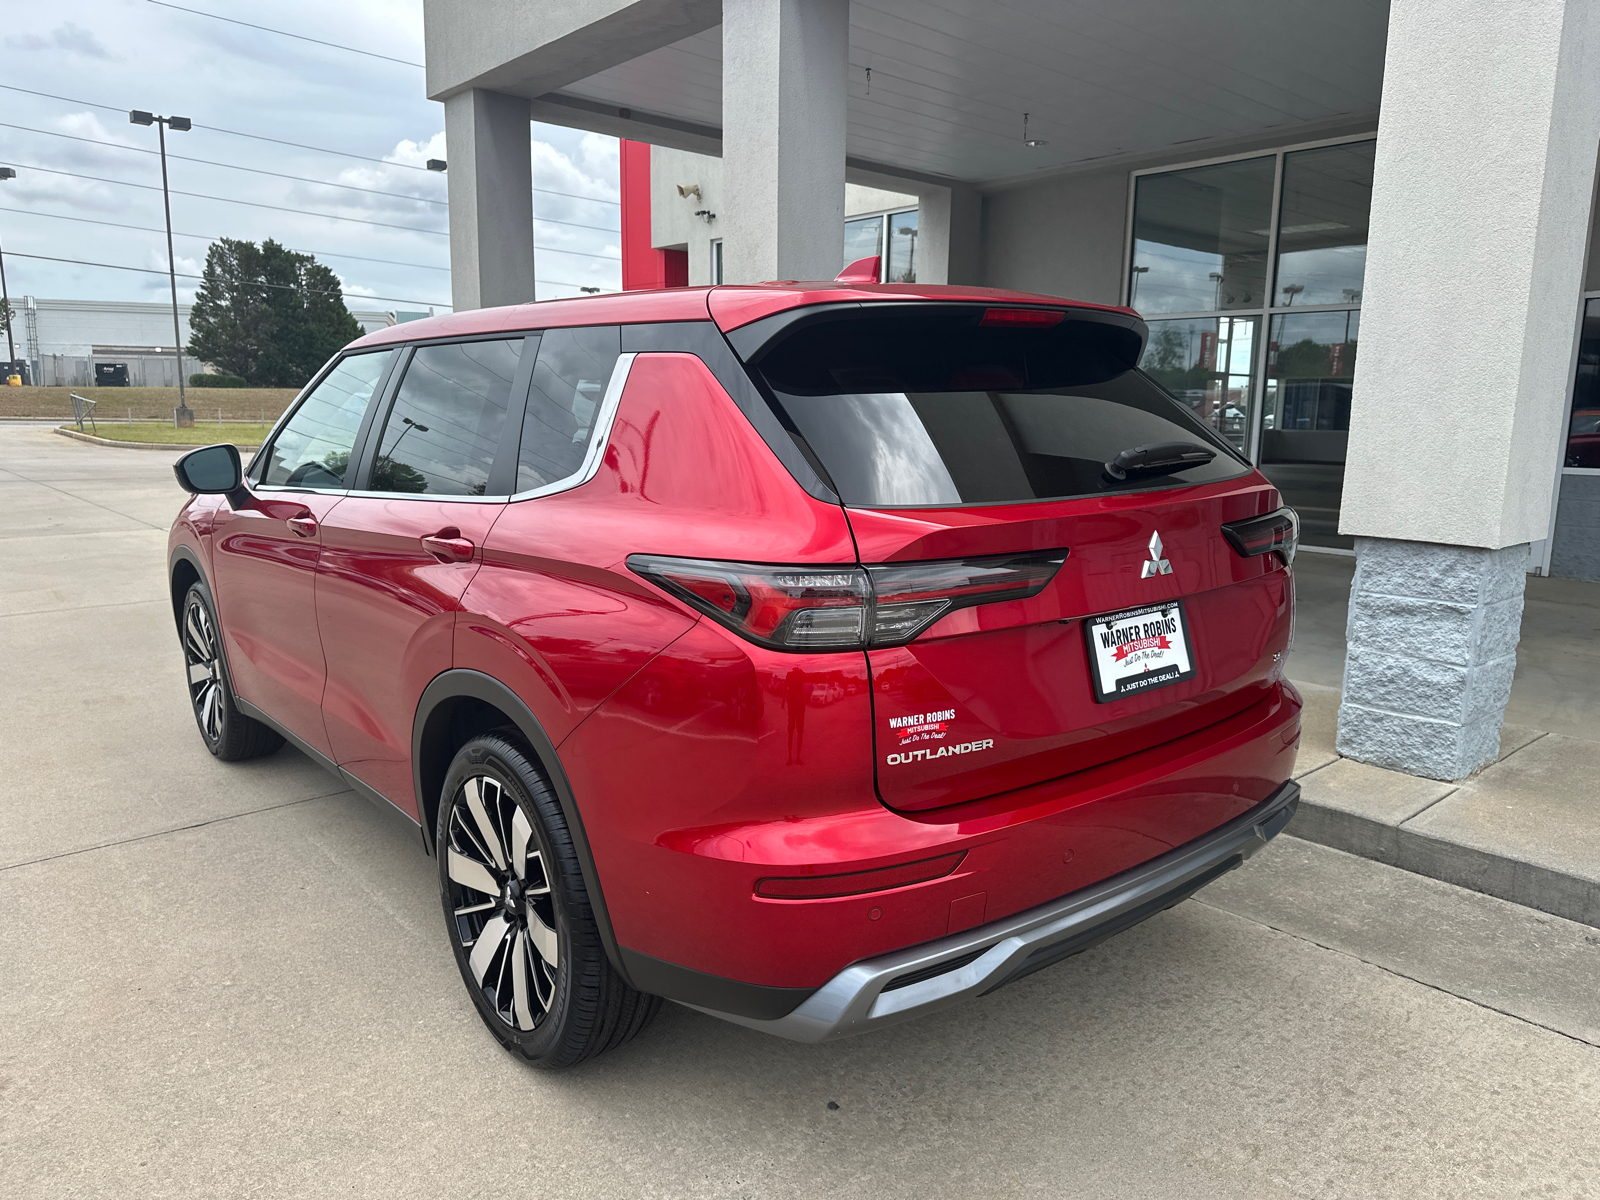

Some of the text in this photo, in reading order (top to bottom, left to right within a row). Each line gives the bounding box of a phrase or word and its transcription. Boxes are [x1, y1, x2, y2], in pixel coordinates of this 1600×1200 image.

[1100, 617, 1177, 648] WARNER ROBINS
[1122, 637, 1161, 654] MITSUBISHI
[1123, 655, 1134, 667] Just
[1134, 653, 1141, 662] Do
[1142, 651, 1150, 660] The
[1125, 673, 1174, 691] JUST DO THE DEAL!
[889, 709, 955, 728] WARNER ROBINS
[907, 723, 940, 734] MITSUBISHI
[899, 737, 911, 745] Just
[912, 734, 920, 742] Do
[887, 739, 994, 765] OUTLANDER
